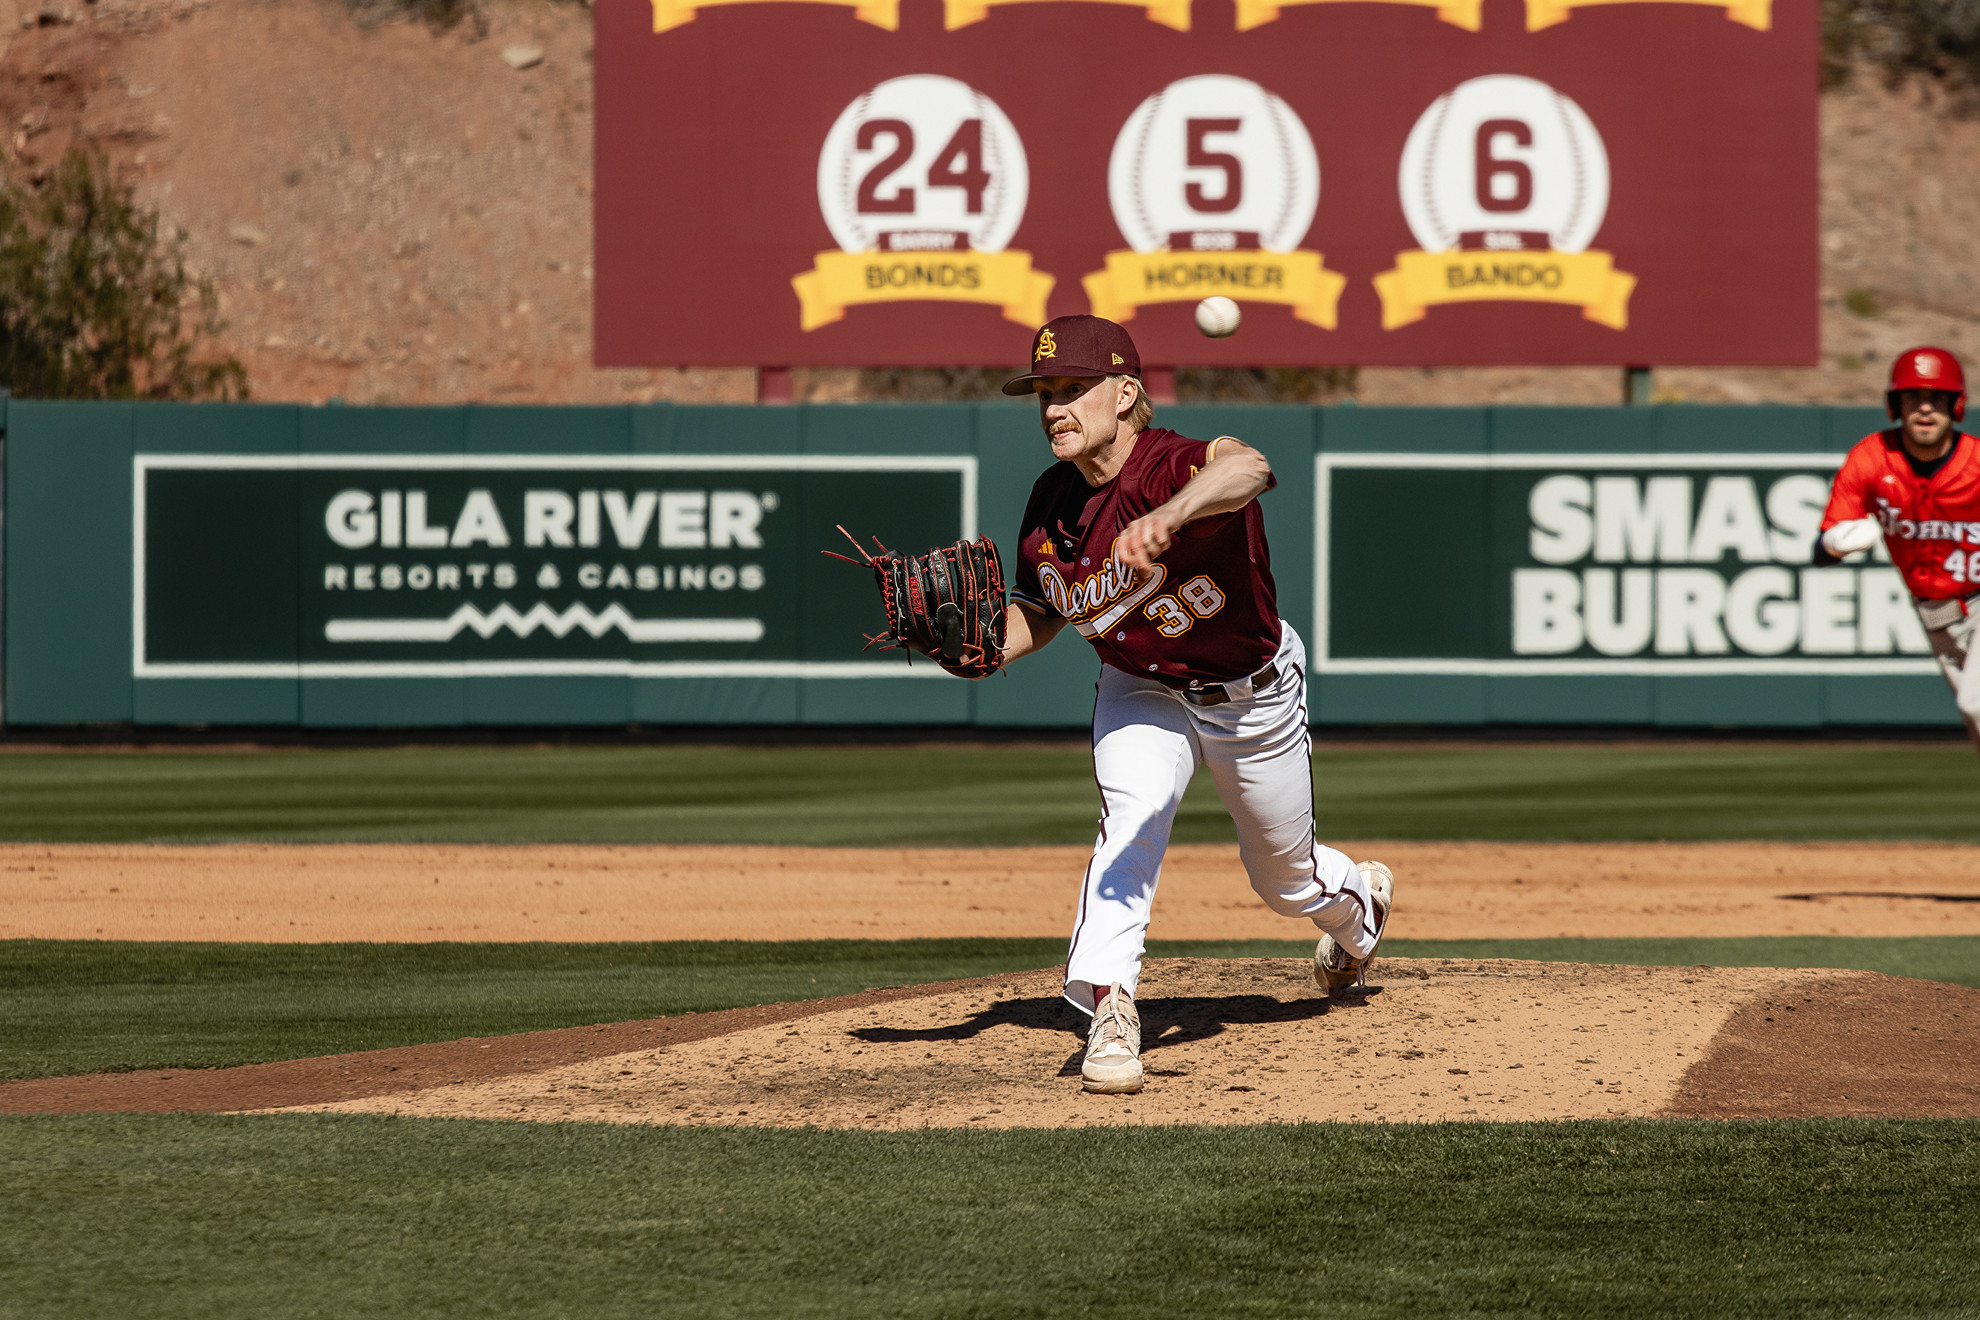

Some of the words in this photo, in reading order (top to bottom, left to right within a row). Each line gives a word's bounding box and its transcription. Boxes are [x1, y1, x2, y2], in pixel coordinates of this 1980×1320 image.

[856, 119, 991, 214] 24
[1185, 117, 1242, 214] 5
[1475, 119, 1533, 214] 6
[865, 263, 981, 290] BONDS
[1144, 263, 1284, 291] HORNER
[1446, 263, 1563, 290] BANDO
[325, 489, 509, 549] GILA
[1528, 474, 1893, 564] SMAS
[324, 565, 518, 590] RESORTS
[536, 564, 561, 589] &
[578, 564, 765, 591] CASINOS
[909, 576, 924, 615] A2000
[1143, 575, 1226, 638] 38
[1512, 566, 1930, 656] BURGER
